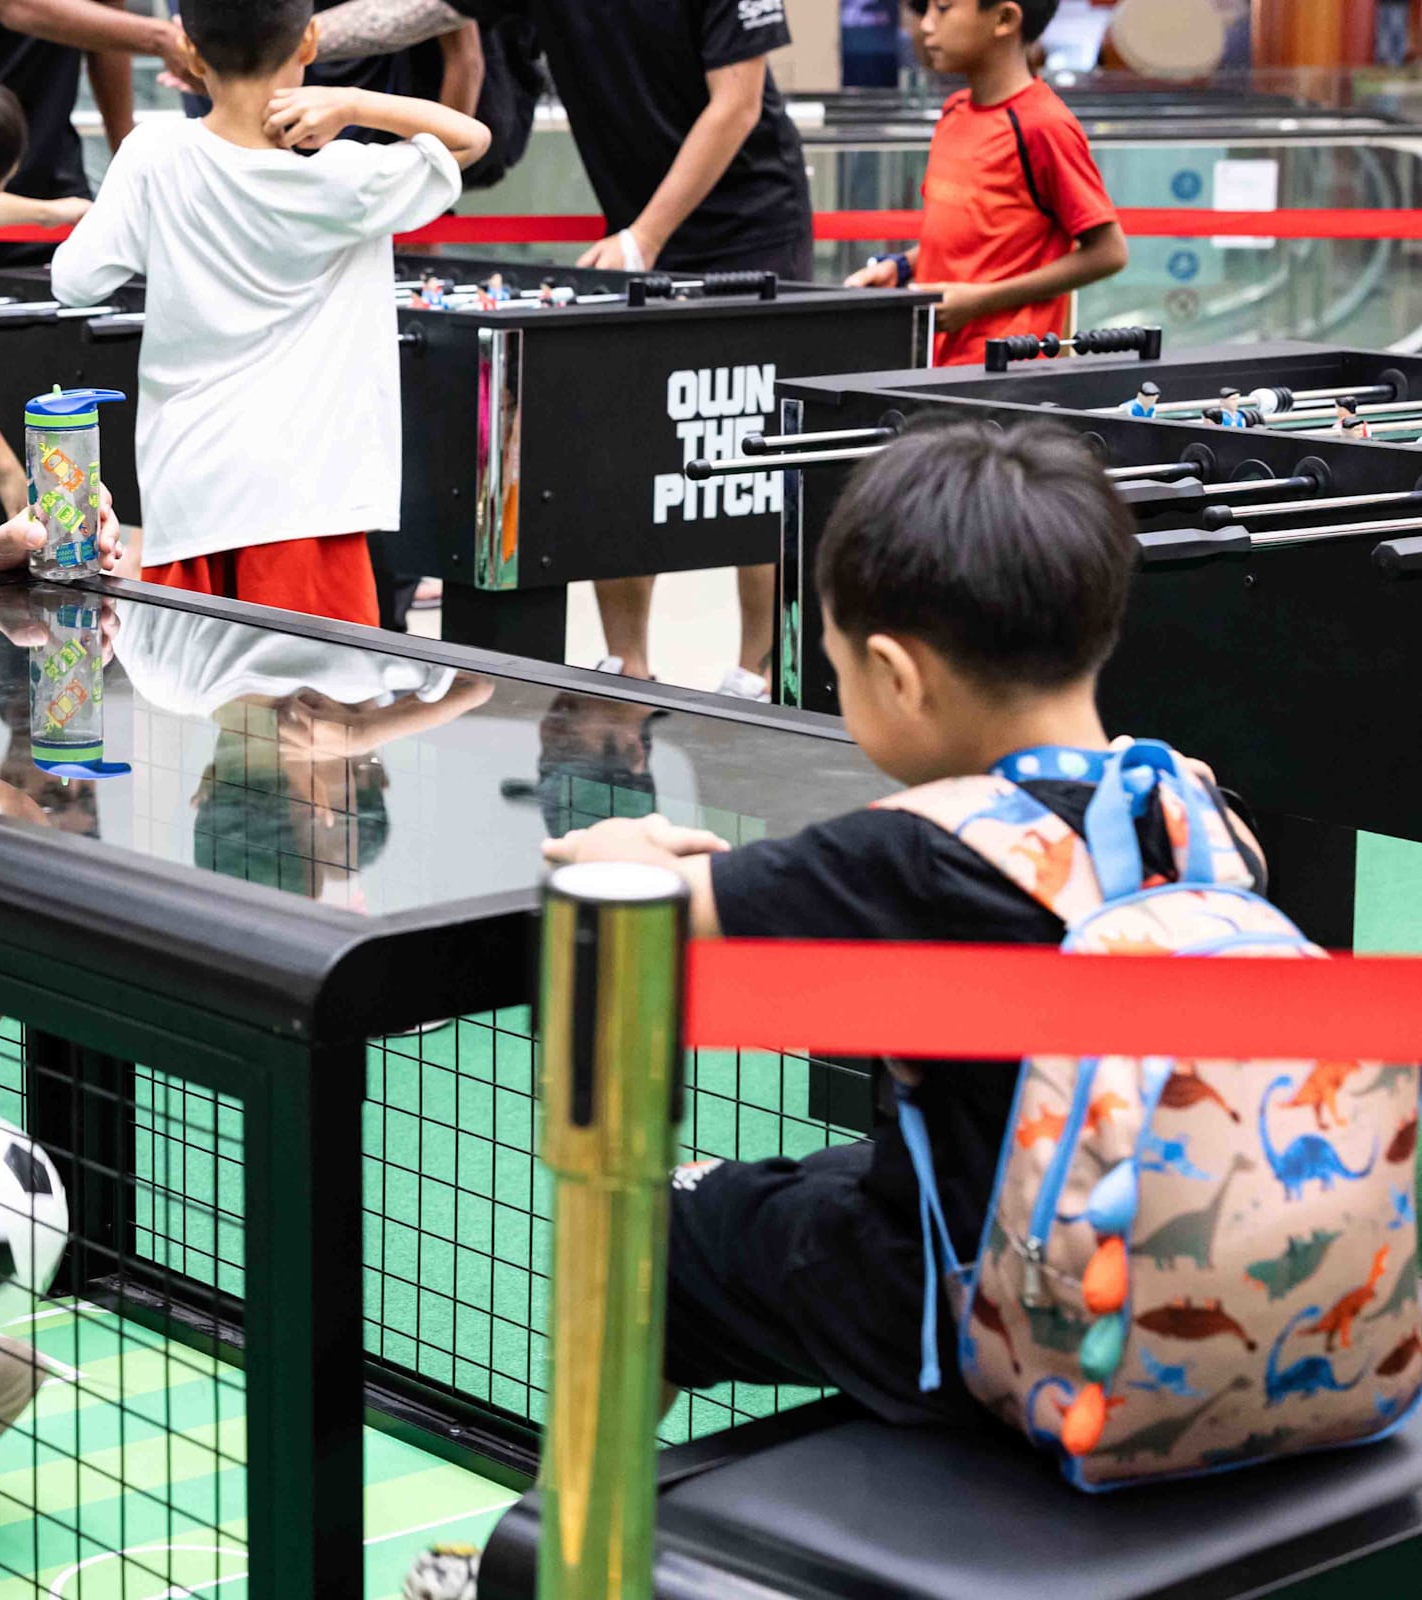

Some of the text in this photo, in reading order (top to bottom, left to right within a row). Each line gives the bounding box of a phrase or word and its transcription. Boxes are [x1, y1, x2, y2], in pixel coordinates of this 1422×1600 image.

[667, 364, 776, 420] OWN
[676, 415, 765, 470] THE
[653, 470, 784, 524] PITCH
